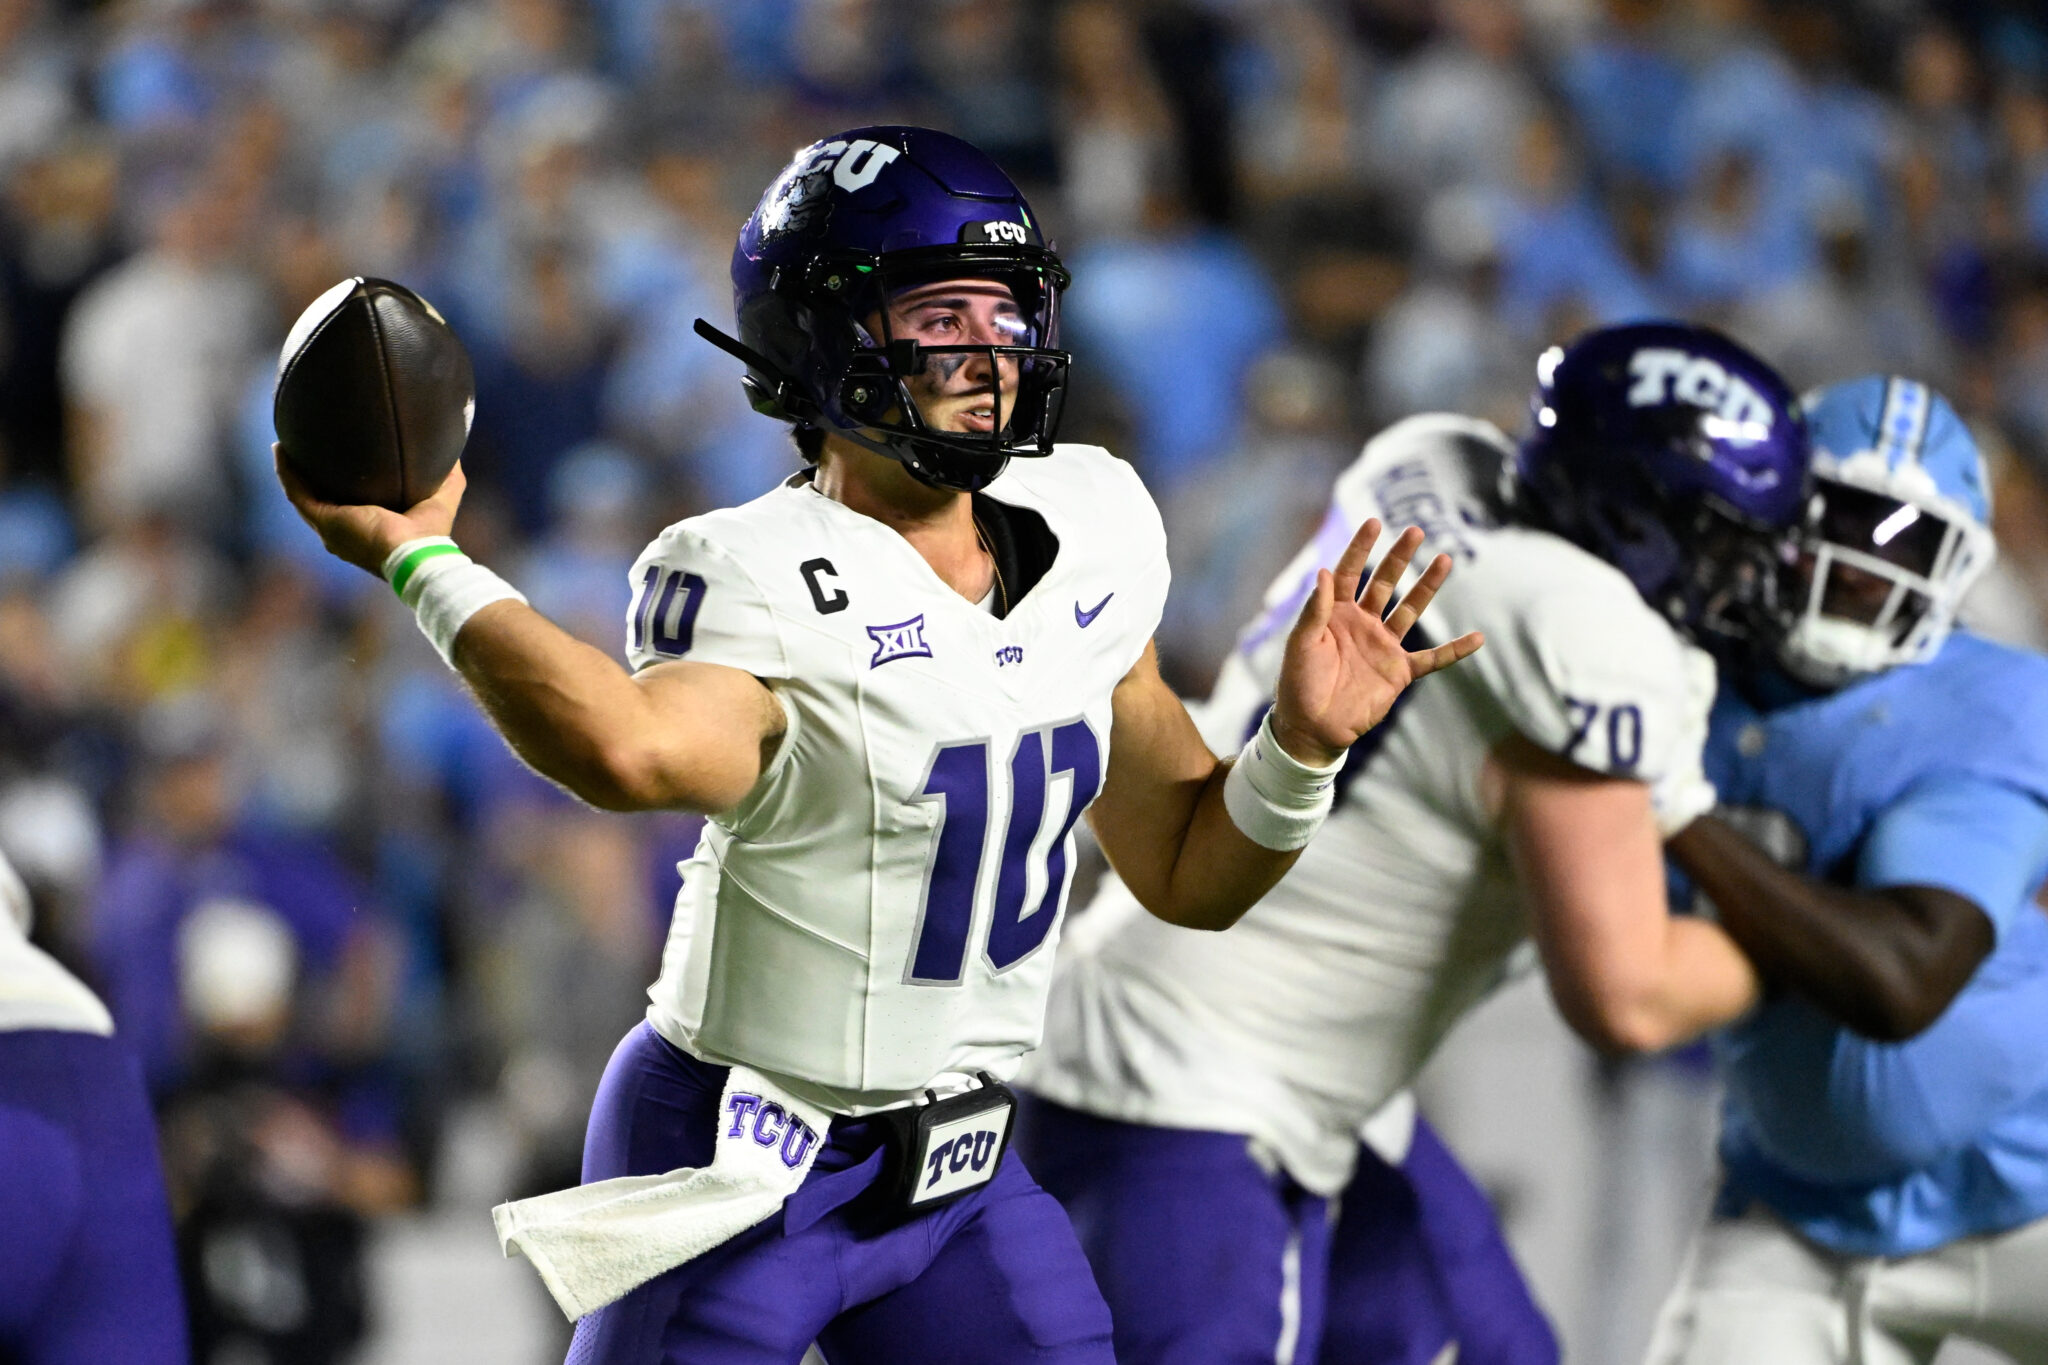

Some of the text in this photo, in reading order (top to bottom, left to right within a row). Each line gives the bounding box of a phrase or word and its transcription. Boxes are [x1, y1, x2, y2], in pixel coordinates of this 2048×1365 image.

[981, 220, 1026, 244] TCU
[1627, 347, 1774, 447] TCU
[633, 565, 708, 659] 10
[800, 557, 849, 615] C
[995, 646, 1023, 667] TCU
[1562, 695, 1642, 774] 70
[902, 712, 1104, 987] 10
[726, 1091, 818, 1170] TCU
[926, 1130, 997, 1190] TCU
